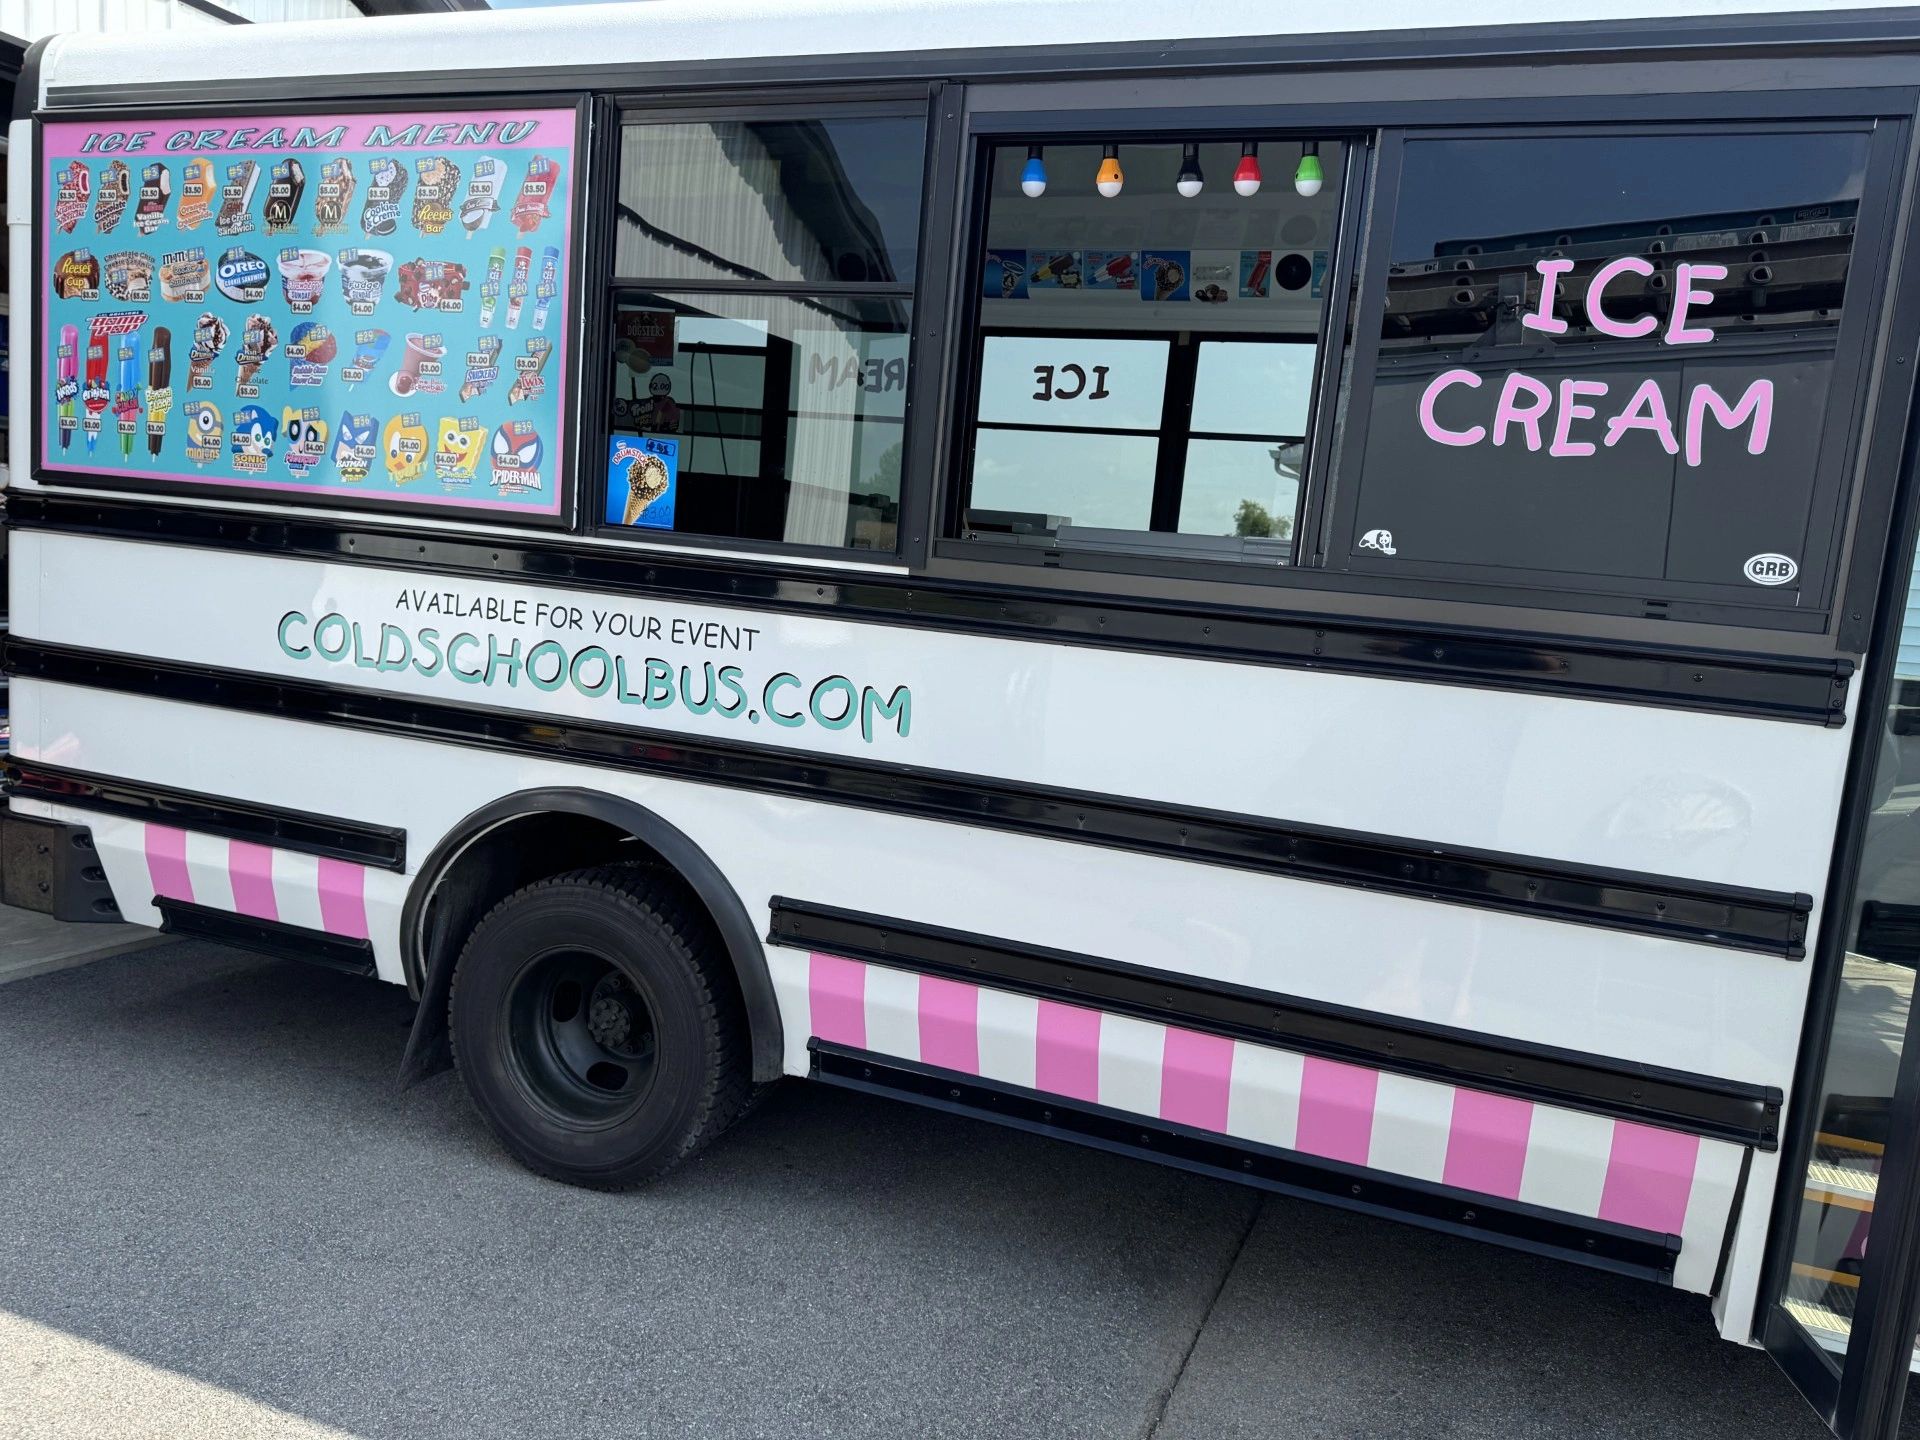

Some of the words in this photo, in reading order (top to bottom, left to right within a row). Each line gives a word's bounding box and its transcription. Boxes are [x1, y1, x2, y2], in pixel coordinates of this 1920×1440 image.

[80, 131, 155, 152] ICE
[165, 126, 349, 151] CREAM
[363, 120, 540, 146] MENU
[370, 159, 387, 171] #8
[417, 158, 433, 171] #9
[475, 160, 494, 176] #10
[530, 159, 548, 175] #11
[143, 167, 158, 178] #3
[185, 166, 199, 177] #4
[228, 165, 243, 176] #5
[273, 164, 288, 176] #6
[322, 164, 337, 176] #7
[101, 170, 114, 181] #2
[141, 188, 157, 198] $3.50
[185, 186, 201, 195] $3.50
[224, 187, 241, 197] $3.50
[272, 186, 289, 195] $5.00
[320, 186, 338, 195] $5.00
[370, 189, 388, 199] $3.50
[418, 188, 438, 197] $3.50
[470, 184, 491, 194] $3.50
[525, 184, 545, 194] $3.50
[60, 191, 75, 199] $3.50
[100, 191, 116, 199] $3.50
[94, 201, 126, 220] Chocolate
[364, 202, 399, 220] Cookies
[137, 212, 164, 220] Vanilla
[373, 211, 401, 224] Creme
[145, 218, 169, 227] Cream
[218, 223, 254, 236] Sandwich
[426, 224, 444, 233] Bar
[227, 247, 243, 259] #15
[340, 248, 357, 261] #17
[220, 260, 266, 278] OREO
[425, 266, 443, 280] #18
[66, 277, 84, 288] Cup
[347, 281, 380, 291] Fudge
[481, 282, 499, 296] #19
[509, 283, 527, 297] #20
[537, 283, 555, 297] #21
[186, 293, 203, 301] $5.00
[245, 290, 262, 299] $4.00
[441, 301, 462, 310] $6.00
[1522, 257, 1728, 345] ICE
[293, 303, 311, 312] $4.00
[353, 304, 373, 313] $4.00
[310, 326, 327, 339] #28
[356, 330, 374, 344] #29
[479, 336, 496, 348] #31
[286, 347, 304, 356] $4.00
[468, 355, 488, 364] $3.00
[516, 359, 537, 369] $3.00
[420, 364, 440, 373] $3.00
[344, 370, 362, 379] $3.00
[467, 368, 497, 380] SNICKERS
[194, 378, 211, 387] $5.00
[240, 387, 258, 396] $5.00
[303, 407, 318, 418] #35
[403, 413, 419, 426] #37
[1418, 369, 1774, 467] CREAM
[61, 420, 76, 428] $3.00
[84, 420, 99, 429] $3.00
[119, 423, 134, 432] $3.00
[148, 424, 163, 433] $3.00
[514, 420, 532, 434] #39
[203, 439, 220, 448] $4.00
[232, 435, 249, 444] $4.00
[305, 443, 323, 452] $4.00
[400, 441, 419, 450] $4.00
[355, 447, 374, 456] $4.00
[234, 454, 266, 464] SONIC
[436, 454, 455, 464] $4.00
[498, 457, 518, 466] $4.00
[612, 447, 649, 468] DRUMSTICK
[335, 459, 368, 468] BATMAN
[490, 469, 542, 490] SPIDER-MAN
[1752, 561, 1790, 577] GRB
[396, 589, 527, 624] AVAILABLE
[536, 603, 583, 630] FOR
[592, 610, 661, 640] YOUR
[671, 618, 760, 651] EVENT
[277, 610, 912, 743] COLDSCHOOLBUS.COM
